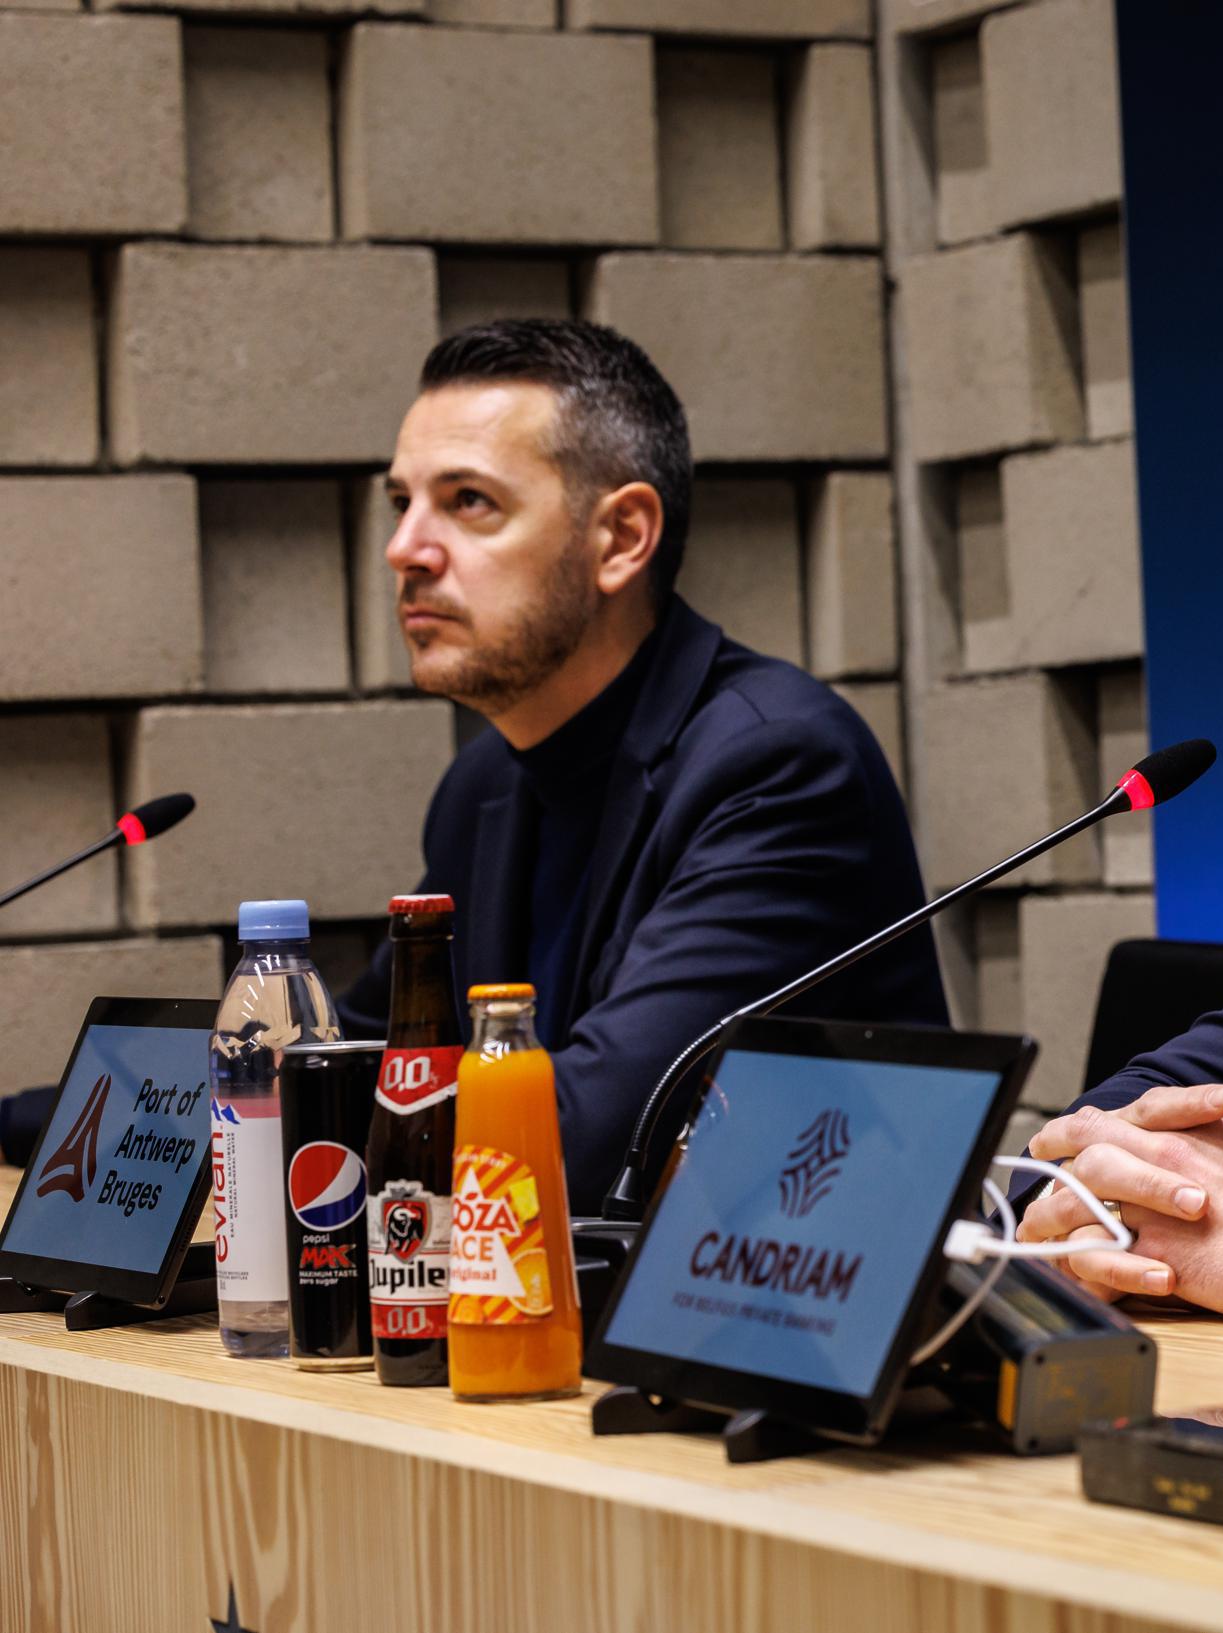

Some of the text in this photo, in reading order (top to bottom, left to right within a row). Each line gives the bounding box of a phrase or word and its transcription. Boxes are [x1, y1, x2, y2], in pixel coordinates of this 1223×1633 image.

[133, 1078, 206, 1117] Port of
[114, 1124, 196, 1174] Antwerp
[97, 1169, 163, 1217] Bruges
[452, 1196, 517, 1233] OZA
[300, 1244, 356, 1269] MAX
[302, 1233, 330, 1245] pepsi
[368, 1258, 450, 1295] Jupile
[690, 1230, 865, 1305] CANDRIAM
